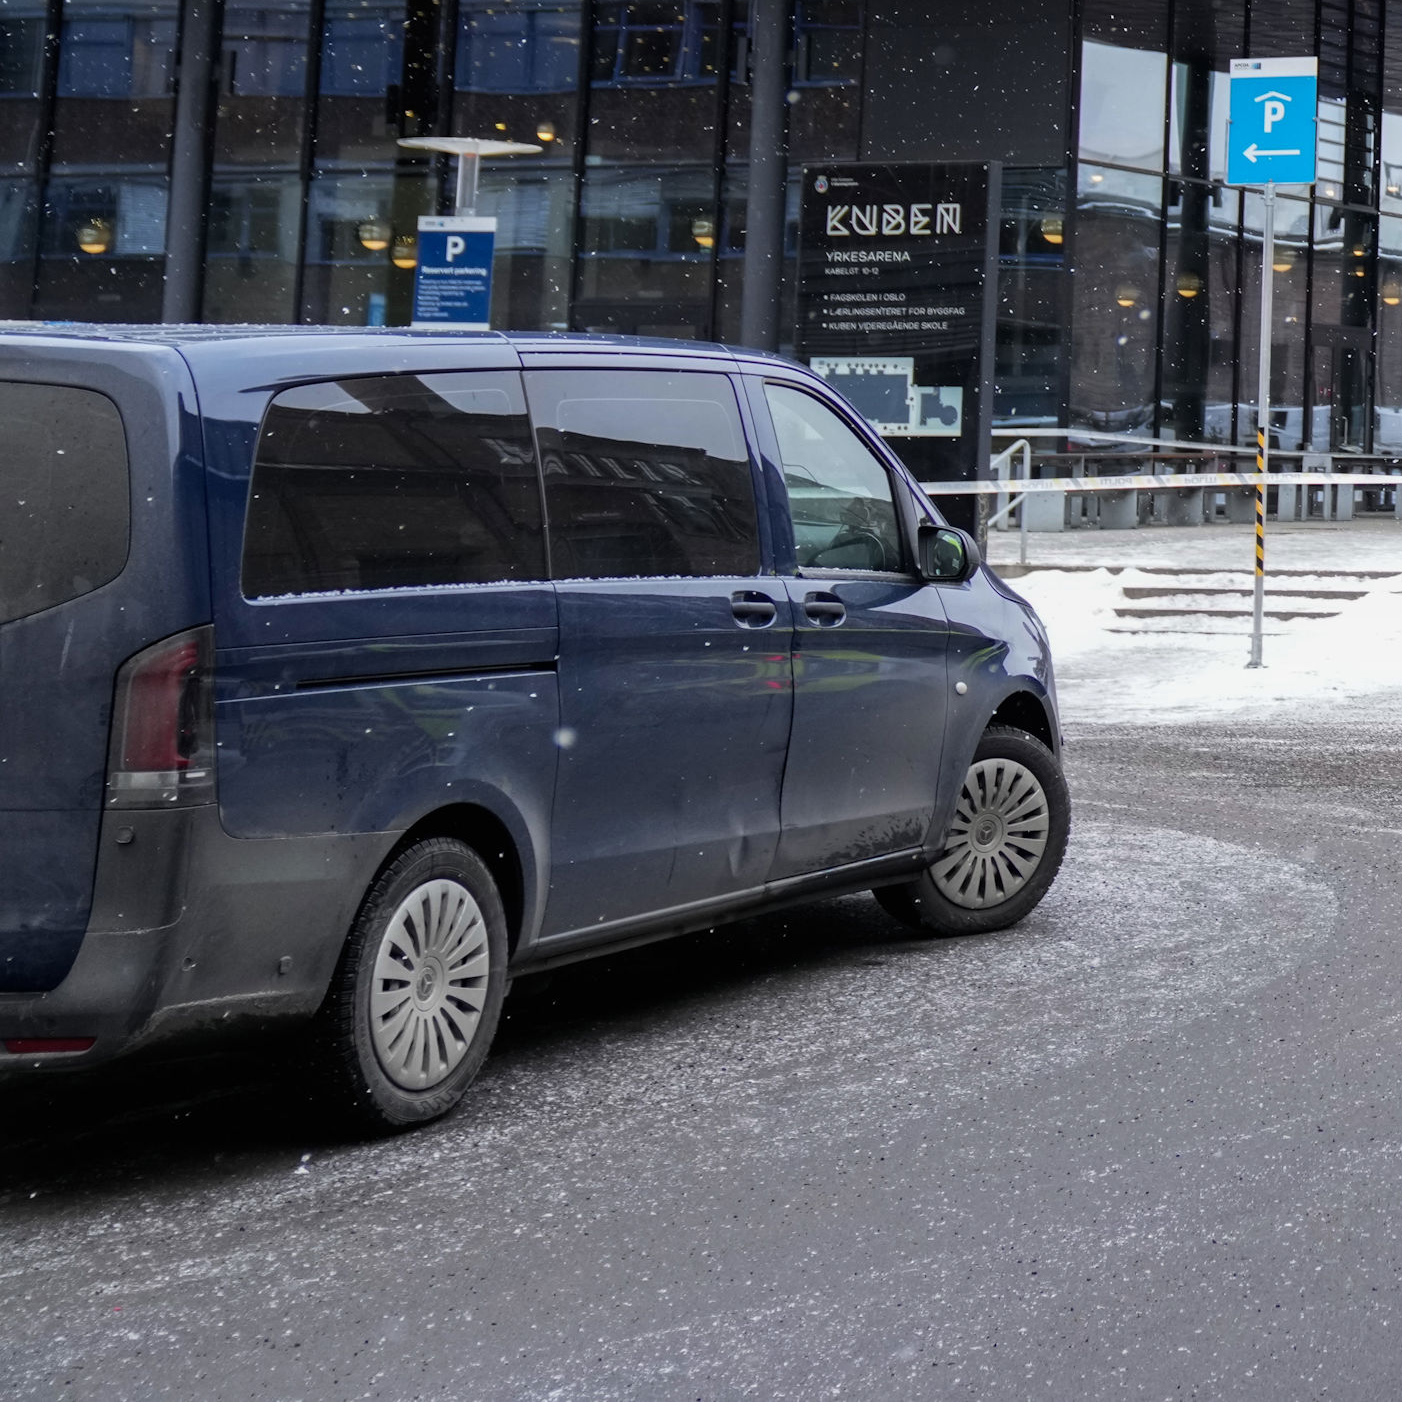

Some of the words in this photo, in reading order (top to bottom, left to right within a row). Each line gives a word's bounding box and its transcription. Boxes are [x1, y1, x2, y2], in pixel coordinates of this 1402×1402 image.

[1264, 100, 1285, 133] P
[826, 203, 961, 236] KUBEN
[446, 236, 466, 263] P
[825, 251, 911, 263] YRKESARENA
[825, 267, 859, 275] KABELGT
[829, 293, 877, 302] FAGSKOLEN
[883, 293, 906, 301] OSLO
[908, 307, 925, 315] FOR
[926, 307, 965, 316] BYGGFAG
[828, 322, 857, 330] KUBEN
[858, 320, 920, 330] VIDEREGÅENDE
[921, 321, 948, 330] SKOLE
